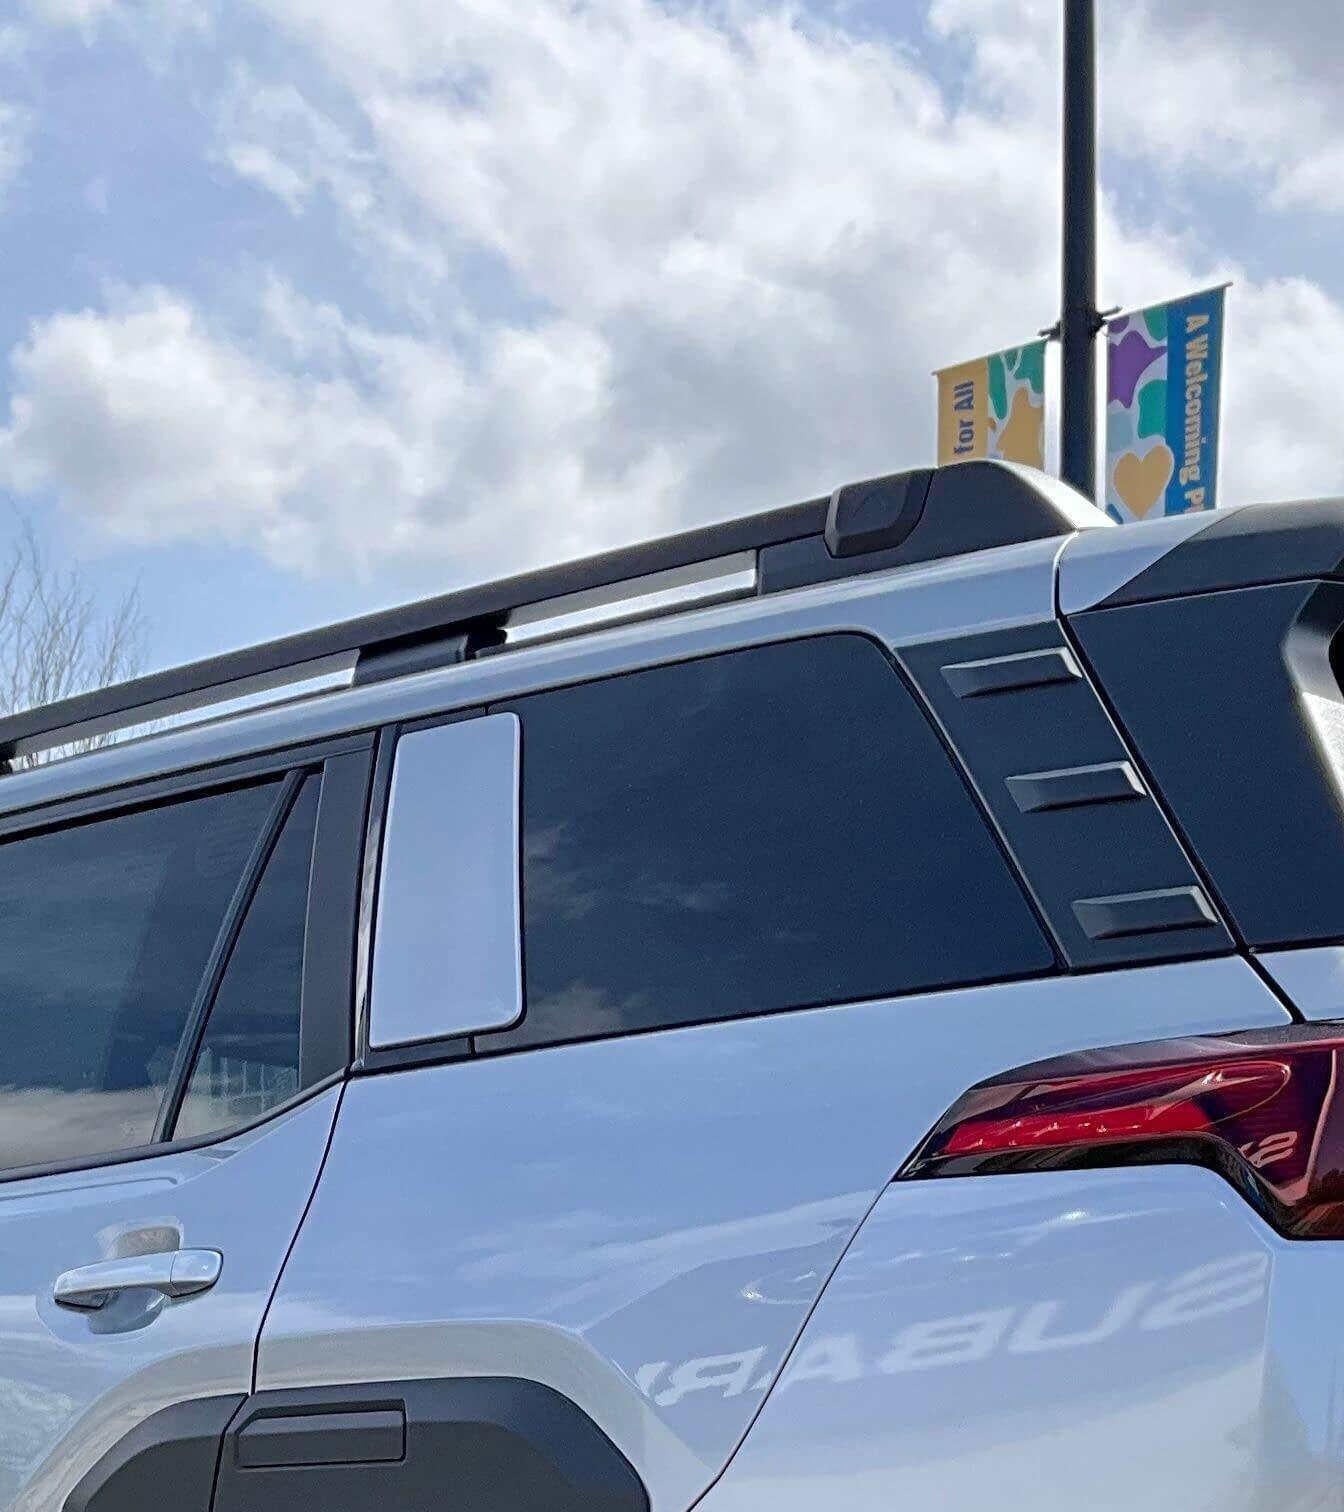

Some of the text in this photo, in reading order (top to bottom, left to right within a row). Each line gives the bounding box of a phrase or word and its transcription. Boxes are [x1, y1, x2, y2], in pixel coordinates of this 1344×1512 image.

[1184, 314, 1209, 334] A
[953, 381, 974, 454] for All
[1179, 333, 1208, 486] Welcoming
